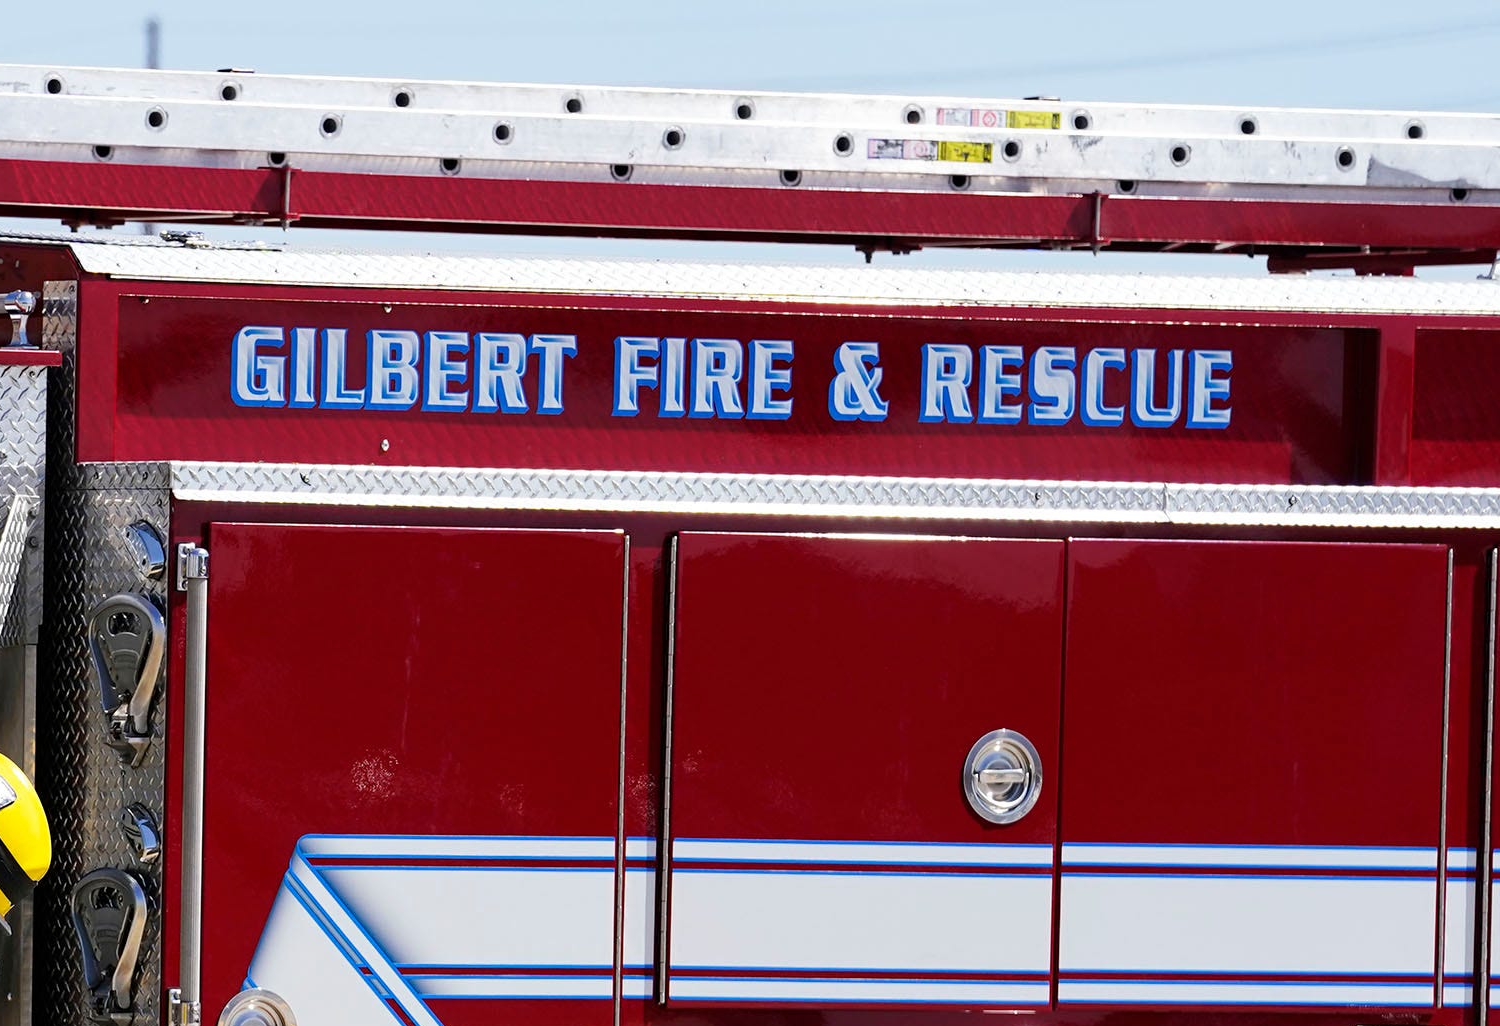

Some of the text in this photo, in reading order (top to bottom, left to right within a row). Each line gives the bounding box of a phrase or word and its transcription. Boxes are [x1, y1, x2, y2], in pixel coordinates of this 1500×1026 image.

[231, 325, 1234, 430] GILBERT FIRE & RESCUE
